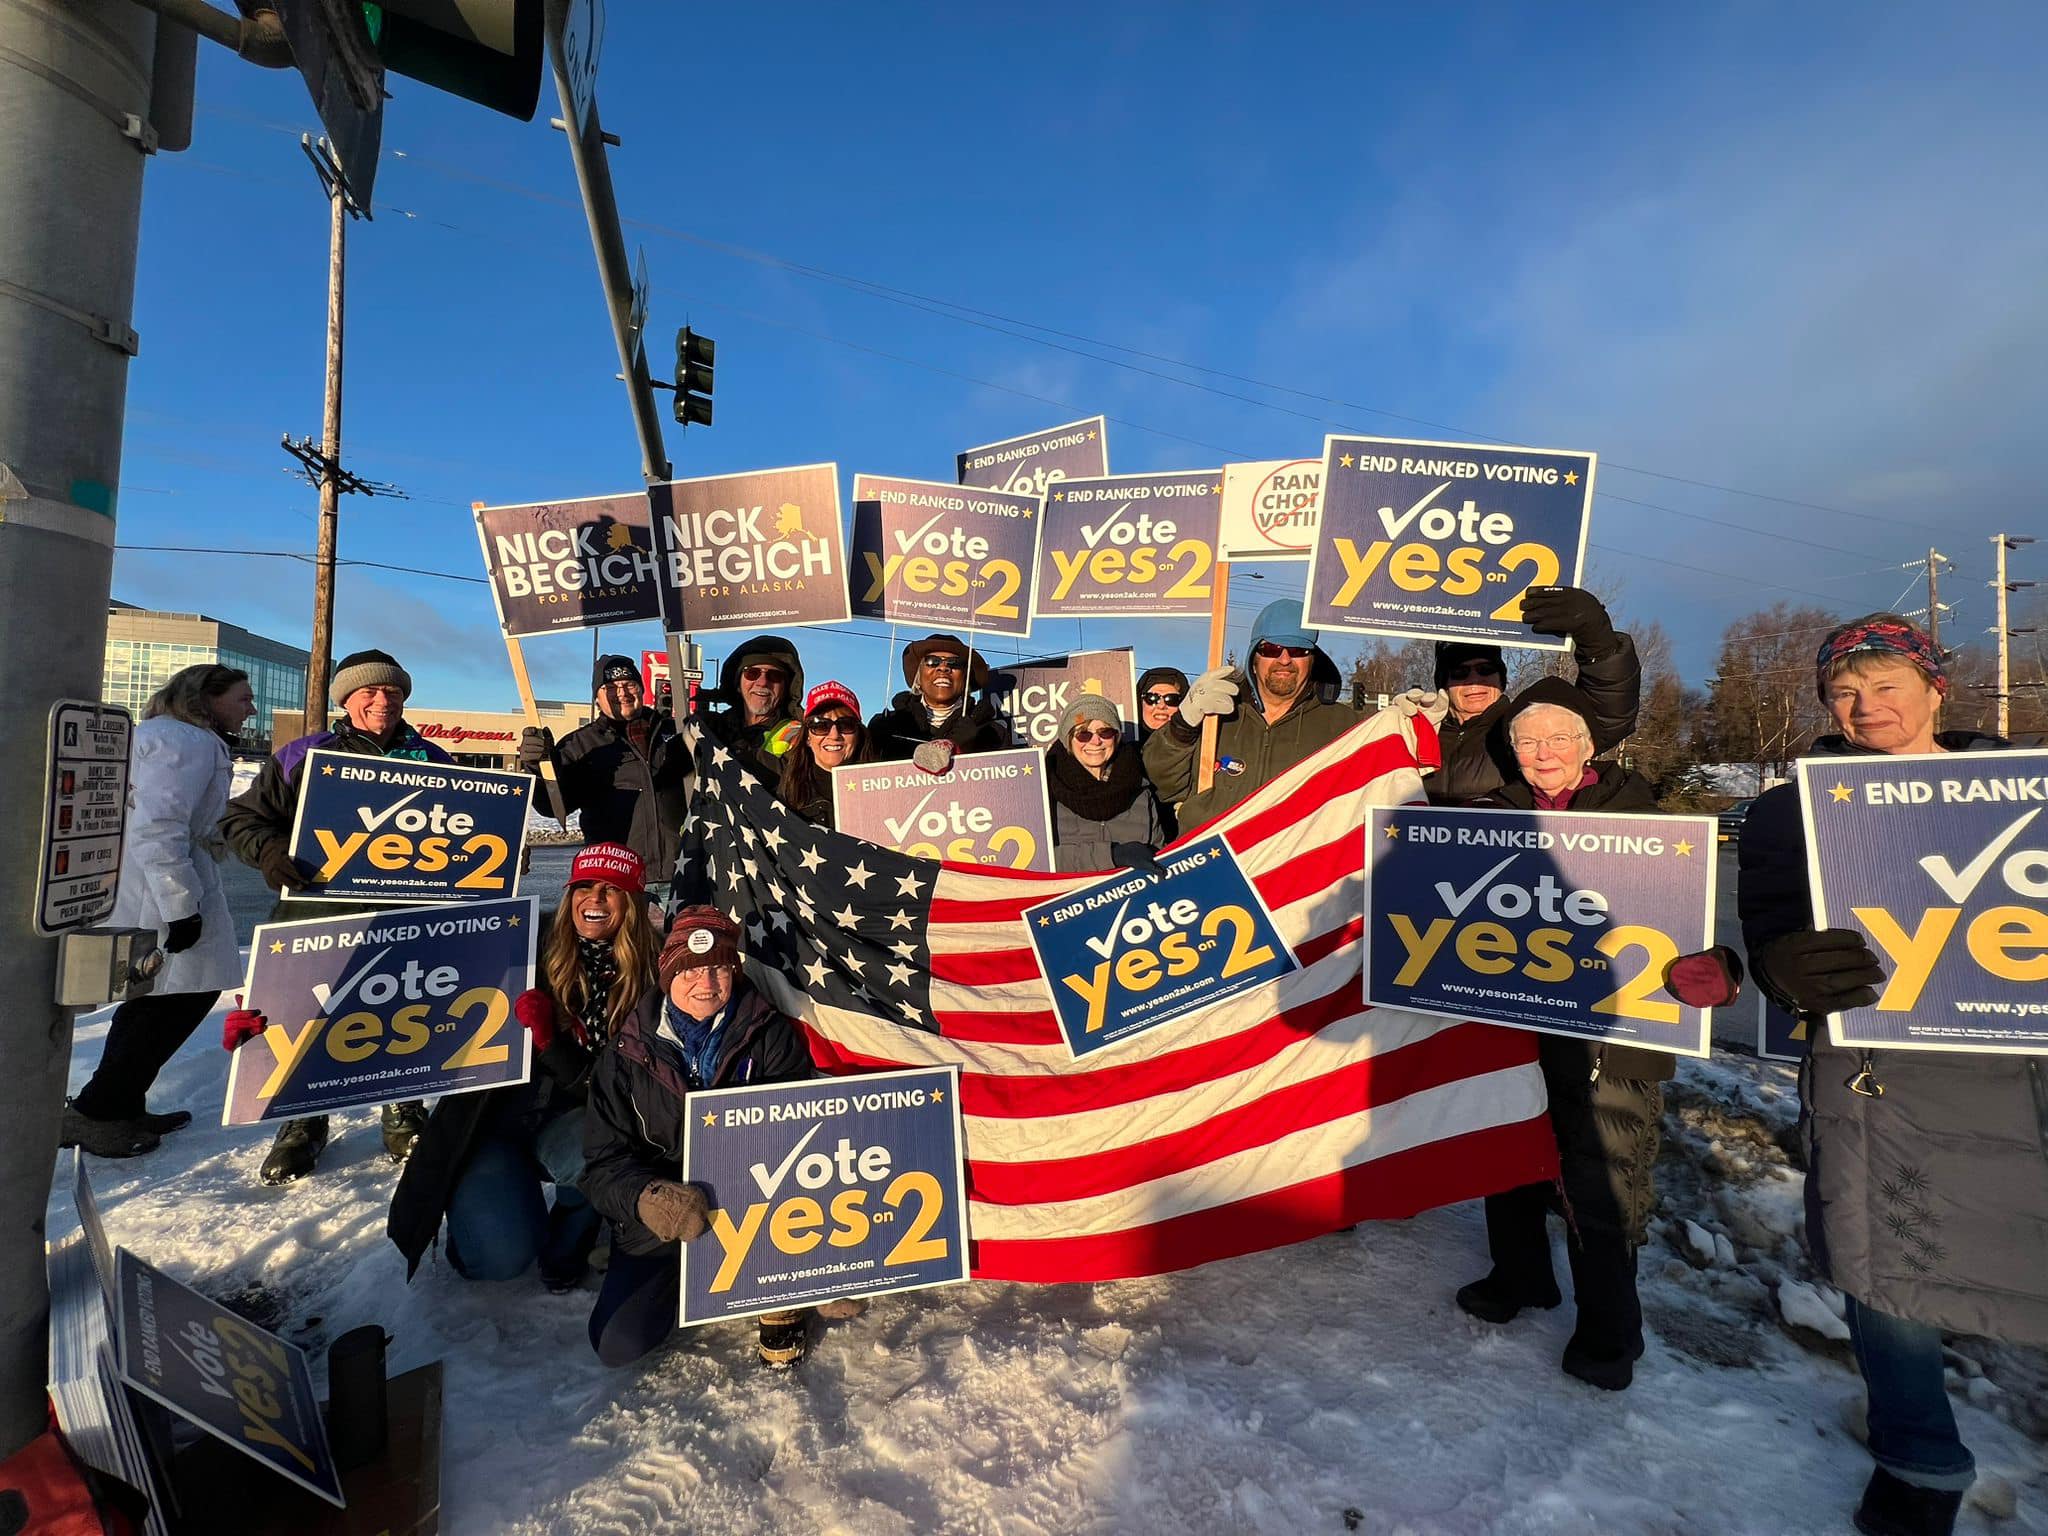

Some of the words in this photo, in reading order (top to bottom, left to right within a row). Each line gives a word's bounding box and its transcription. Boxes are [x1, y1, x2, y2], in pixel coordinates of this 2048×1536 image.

[568, 31, 587, 112] ONLY
[974, 455, 995, 469] END
[996, 444, 1040, 463] RANKED
[1042, 432, 1085, 452] VOTING
[1359, 456, 1396, 473] END
[1400, 459, 1480, 479] RANKED
[1482, 465, 1558, 485] VOTING
[880, 490, 906, 504] END
[909, 494, 964, 512] RANKED
[967, 500, 1020, 518] VOTING
[1067, 489, 1094, 503] END
[1097, 486, 1151, 501] RANKED
[1153, 483, 1208, 498] VOTING
[1377, 481, 1514, 545] Vote
[495, 526, 600, 565] NICK
[663, 505, 767, 550] NICK
[894, 512, 990, 560] Vote
[1080, 502, 1178, 550] Vote
[503, 551, 657, 597] BEGICH
[667, 537, 832, 588] BEGICH
[862, 551, 970, 603] yes
[971, 578, 986, 588] on
[1050, 547, 1158, 600] yes
[1158, 561, 1174, 572] on
[1163, 539, 1212, 599] 2
[1329, 538, 1485, 607] yes
[1486, 570, 1507, 583] on
[1489, 542, 1560, 622] 2
[538, 595, 569, 605] FOR
[578, 586, 639, 600] ALASKA
[700, 586, 730, 598] FOR
[740, 579, 806, 594] ALASKA
[892, 599, 969, 614] www.yeson2ak.com
[974, 560, 1022, 619] 2
[1080, 591, 1157, 602] www.yeson2ak.com
[1372, 600, 1481, 618] www.yeson2ak.com
[990, 681, 1071, 718] NICK
[416, 724, 517, 743] Walgreens
[340, 766, 376, 782] END
[379, 771, 447, 789] RANKED
[450, 777, 509, 796] VOTING
[862, 777, 889, 793] END
[894, 771, 956, 789] RANKED
[960, 765, 1018, 780] VOTING
[1865, 782, 1933, 805] END
[357, 789, 474, 835] Vote
[884, 788, 993, 843] Vote
[312, 829, 451, 883] yes
[451, 852, 469, 863] on
[454, 833, 508, 889] 2
[577, 846, 600, 858] MAKE
[600, 845, 639, 864] AMERICA
[980, 853, 997, 864] on
[1408, 826, 1452, 843] END
[1457, 828, 1554, 850] RANKED
[1560, 833, 1664, 856] VOTING
[351, 876, 448, 888] www.yeson2ak.com
[579, 858, 605, 869] GREAT
[604, 860, 632, 874] AGAIN
[1053, 903, 1084, 923] END
[1085, 878, 1147, 910] RANKED
[1434, 852, 1609, 926] Vote
[291, 934, 333, 955] END
[337, 925, 421, 948] RANKED
[426, 916, 501, 936] VOTING
[1085, 897, 1199, 960] Vote
[1198, 939, 1216, 951] on
[1201, 905, 1276, 979] 2
[1387, 913, 1575, 987] yes
[311, 946, 460, 1015] Vote
[1579, 956, 1607, 971] on
[1590, 925, 1681, 1024] 2
[1851, 906, 2048, 1011] ye
[1061, 932, 1200, 1033] yes
[1120, 975, 1215, 1019] www.yeson2ak.com
[1441, 982, 1578, 1009] www.yeson2ak.com
[434, 1020, 456, 1034] on
[440, 986, 510, 1070] 2
[256, 1004, 432, 1099] yes
[307, 1064, 431, 1090] www.yeson2ak.com
[724, 1108, 764, 1128] END
[769, 1098, 849, 1122] RANKED
[855, 1089, 925, 1112] VOTING
[749, 1121, 892, 1200] Vote
[873, 1209, 894, 1224] on
[882, 1171, 948, 1267] 2
[707, 1190, 870, 1294] yes
[757, 1258, 874, 1285] www.yeson2ak.com
[212, 1317, 291, 1376] 2
[227, 1352, 315, 1473] yes
